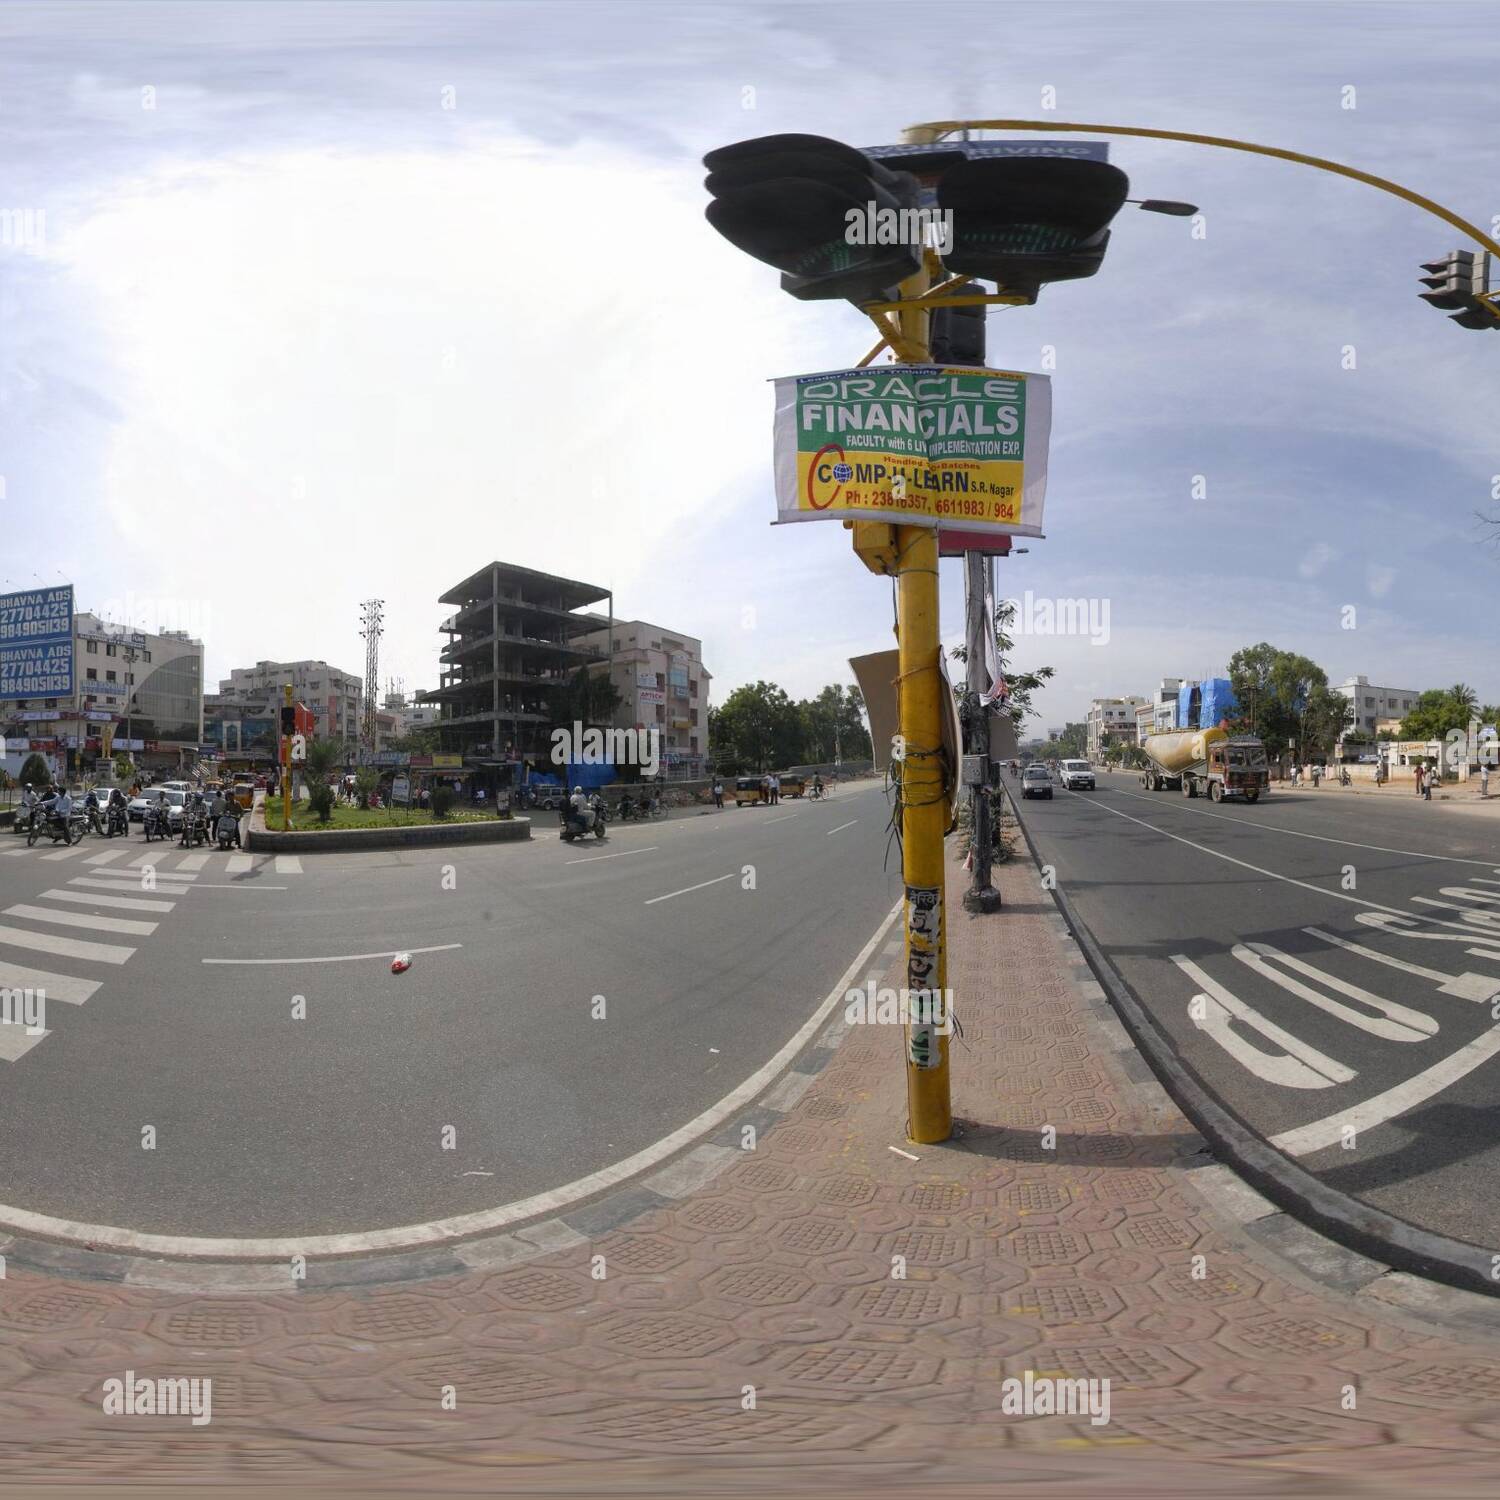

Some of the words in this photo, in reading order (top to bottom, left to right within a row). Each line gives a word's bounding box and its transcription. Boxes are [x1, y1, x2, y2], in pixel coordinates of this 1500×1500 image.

[803, 377, 1019, 400] ORACLE
[803, 403, 1019, 438] FINANCIALS
[846, 434, 885, 447] FACULTY
[887, 436, 905, 450] with
[907, 438, 913, 451] 6
[914, 439, 928, 453] LIV
[929, 439, 1000, 457] IMPLEMENTATION
[1002, 440, 1020, 455] EXP.
[884, 456, 923, 467] Handled
[971, 480, 988, 493] S.R.
[989, 483, 1014, 498] Nagar
[845, 490, 860, 504] Ph
[994, 503, 1014, 518] 984
[0, 594, 43, 608] BHAVNA
[47, 589, 71, 603] ADS
[0, 602, 68, 623] 27704425
[0, 617, 69, 639] 9849051139
[1, 648, 43, 661] BHAVNA
[47, 645, 72, 658] ADS
[0, 659, 69, 677] 27704425
[1, 675, 70, 693] 9849051139
